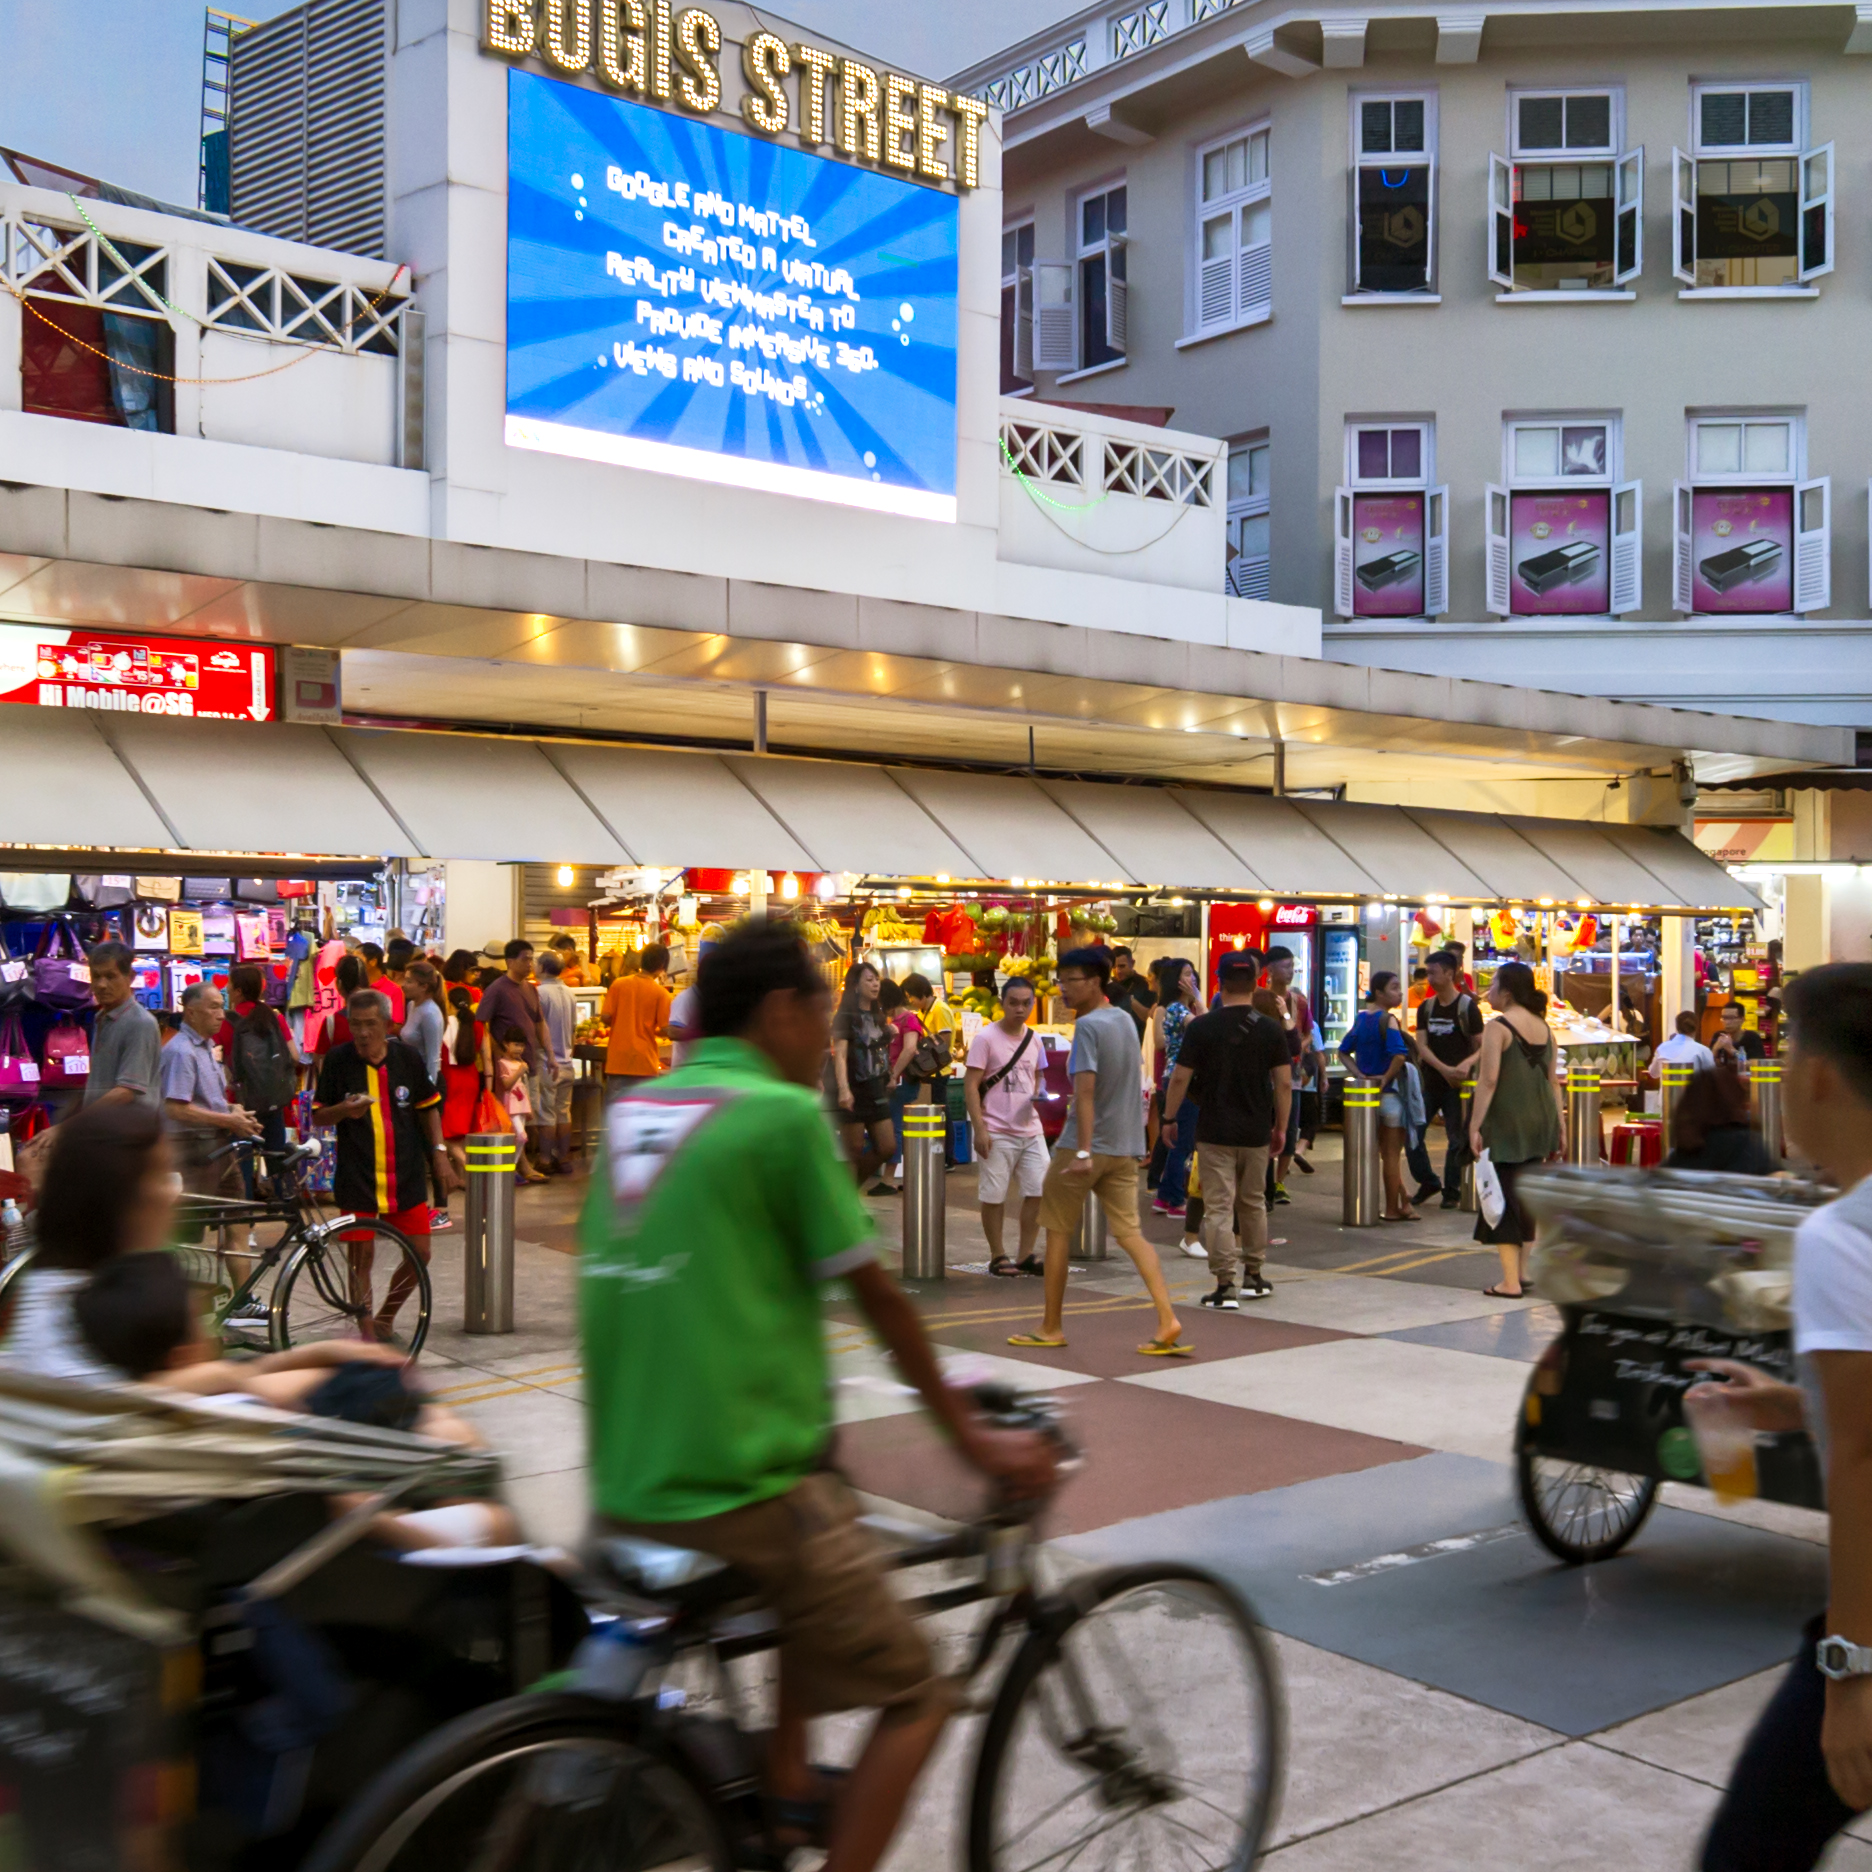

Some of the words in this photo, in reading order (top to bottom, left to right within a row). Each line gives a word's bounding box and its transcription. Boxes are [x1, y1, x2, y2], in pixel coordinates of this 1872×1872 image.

[742, 30, 987, 190] STREET
[607, 165, 690, 208] GOOGLE
[694, 191, 735, 226] AND
[738, 203, 816, 247] MATTEL
[606, 251, 695, 297] REALITY
[700, 277, 824, 331] VIEWMASTER
[829, 304, 855, 331] TO
[663, 222, 756, 269] CREATED
[762, 247, 776, 273] A
[781, 259, 860, 301] VIRTUAL
[613, 341, 677, 378] VIEWS
[683, 355, 724, 387] AND
[730, 360, 807, 407] SOUNDS
[637, 300, 723, 344] PROVIDE
[728, 324, 830, 369] IMMERSIVE
[39, 684, 63, 706] Hi
[66, 686, 194, 716] Mobile@SG
